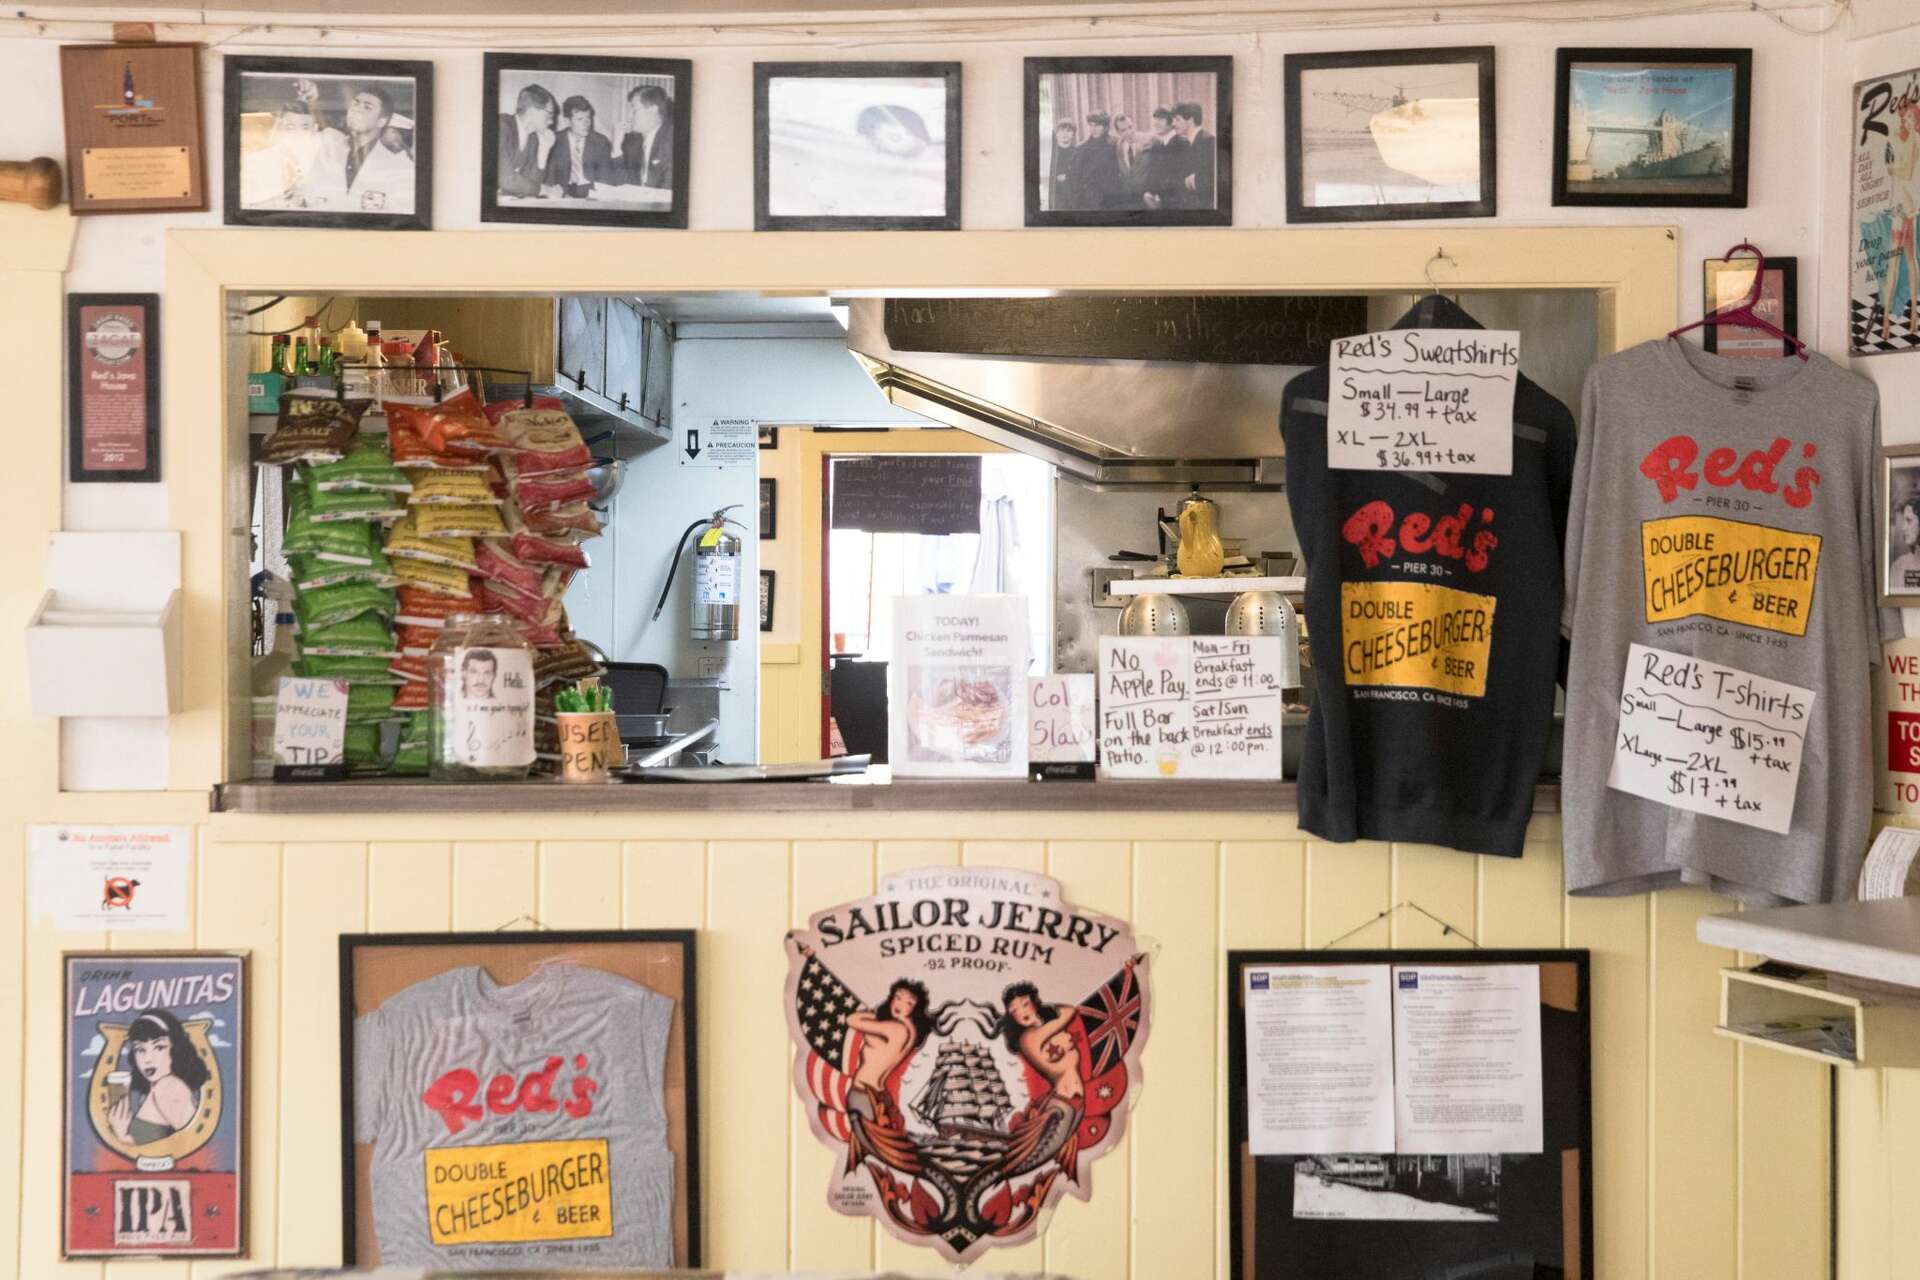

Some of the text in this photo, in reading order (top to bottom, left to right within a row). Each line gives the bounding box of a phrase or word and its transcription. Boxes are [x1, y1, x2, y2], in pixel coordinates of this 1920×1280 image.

[1336, 335, 1392, 359] Red's
[1403, 332, 1519, 366] Sweatshirts
[1342, 377, 1391, 400] Small
[1424, 381, 1470, 409] Large
[1360, 402, 1420, 421] $34.99
[1442, 405, 1478, 425] tax
[1336, 430, 1365, 446] XL
[1394, 431, 1438, 447] 2XL
[1447, 448, 1476, 465] tax
[1638, 434, 1820, 509] Red's
[1706, 496, 1751, 512] PIER 30
[1342, 500, 1499, 573] Red's
[1651, 532, 1715, 556] DOUBLE
[1402, 562, 1444, 576] PIER 30
[1651, 547, 1811, 613] CHEESEBURGER
[1350, 600, 1415, 620] DOUBLE
[1752, 593, 1798, 619] BEER
[934, 616, 980, 628] TODAY!
[1677, 622, 1713, 634] FANCCO,
[1716, 625, 1729, 636] CA
[905, 631, 1008, 643] Chicken Parmesan
[1347, 609, 1486, 675] CHEESEBURGER
[924, 645, 983, 658] Sandwich!
[1110, 648, 1141, 671] No
[1194, 658, 1255, 674] Breakfast
[1444, 657, 1476, 680] BEER
[1643, 652, 1704, 690] Red's
[1888, 655, 1919, 675] WE
[294, 683, 330, 699] WE
[1110, 672, 1154, 699] Apple
[1195, 675, 1222, 687] ends
[1225, 675, 1238, 688] @
[1032, 681, 1070, 709] Col
[1422, 692, 1435, 702] CA
[279, 704, 342, 720] APPRECIATE
[1104, 710, 1175, 731] Full Bar
[1622, 693, 1657, 716] Small
[1677, 709, 1724, 745] Large
[289, 723, 331, 738] YOUR
[1104, 723, 1190, 748] on the back
[1192, 722, 1273, 738] Breakfast ends
[286, 745, 329, 766] TIP
[563, 750, 605, 773] PEN
[1191, 743, 1205, 757] @
[1687, 752, 1729, 774] 2XL
[1763, 752, 1792, 773] tax
[1667, 770, 1738, 797] $17.99
[1734, 795, 1762, 812] tax
[905, 874, 1034, 897] THE ORIGINAL
[817, 897, 1120, 953] SAILOR JERRY
[879, 933, 1056, 966] SPICED RUM
[80, 970, 134, 982] DRINK
[75, 972, 235, 1017] LAGUNITAS
[422, 1054, 597, 1136] Red's
[434, 1160, 508, 1184] DOUBLE
[435, 1152, 603, 1236] CHEESEBURGER
[119, 1187, 187, 1233] IPA
[557, 1205, 601, 1225] BEER
